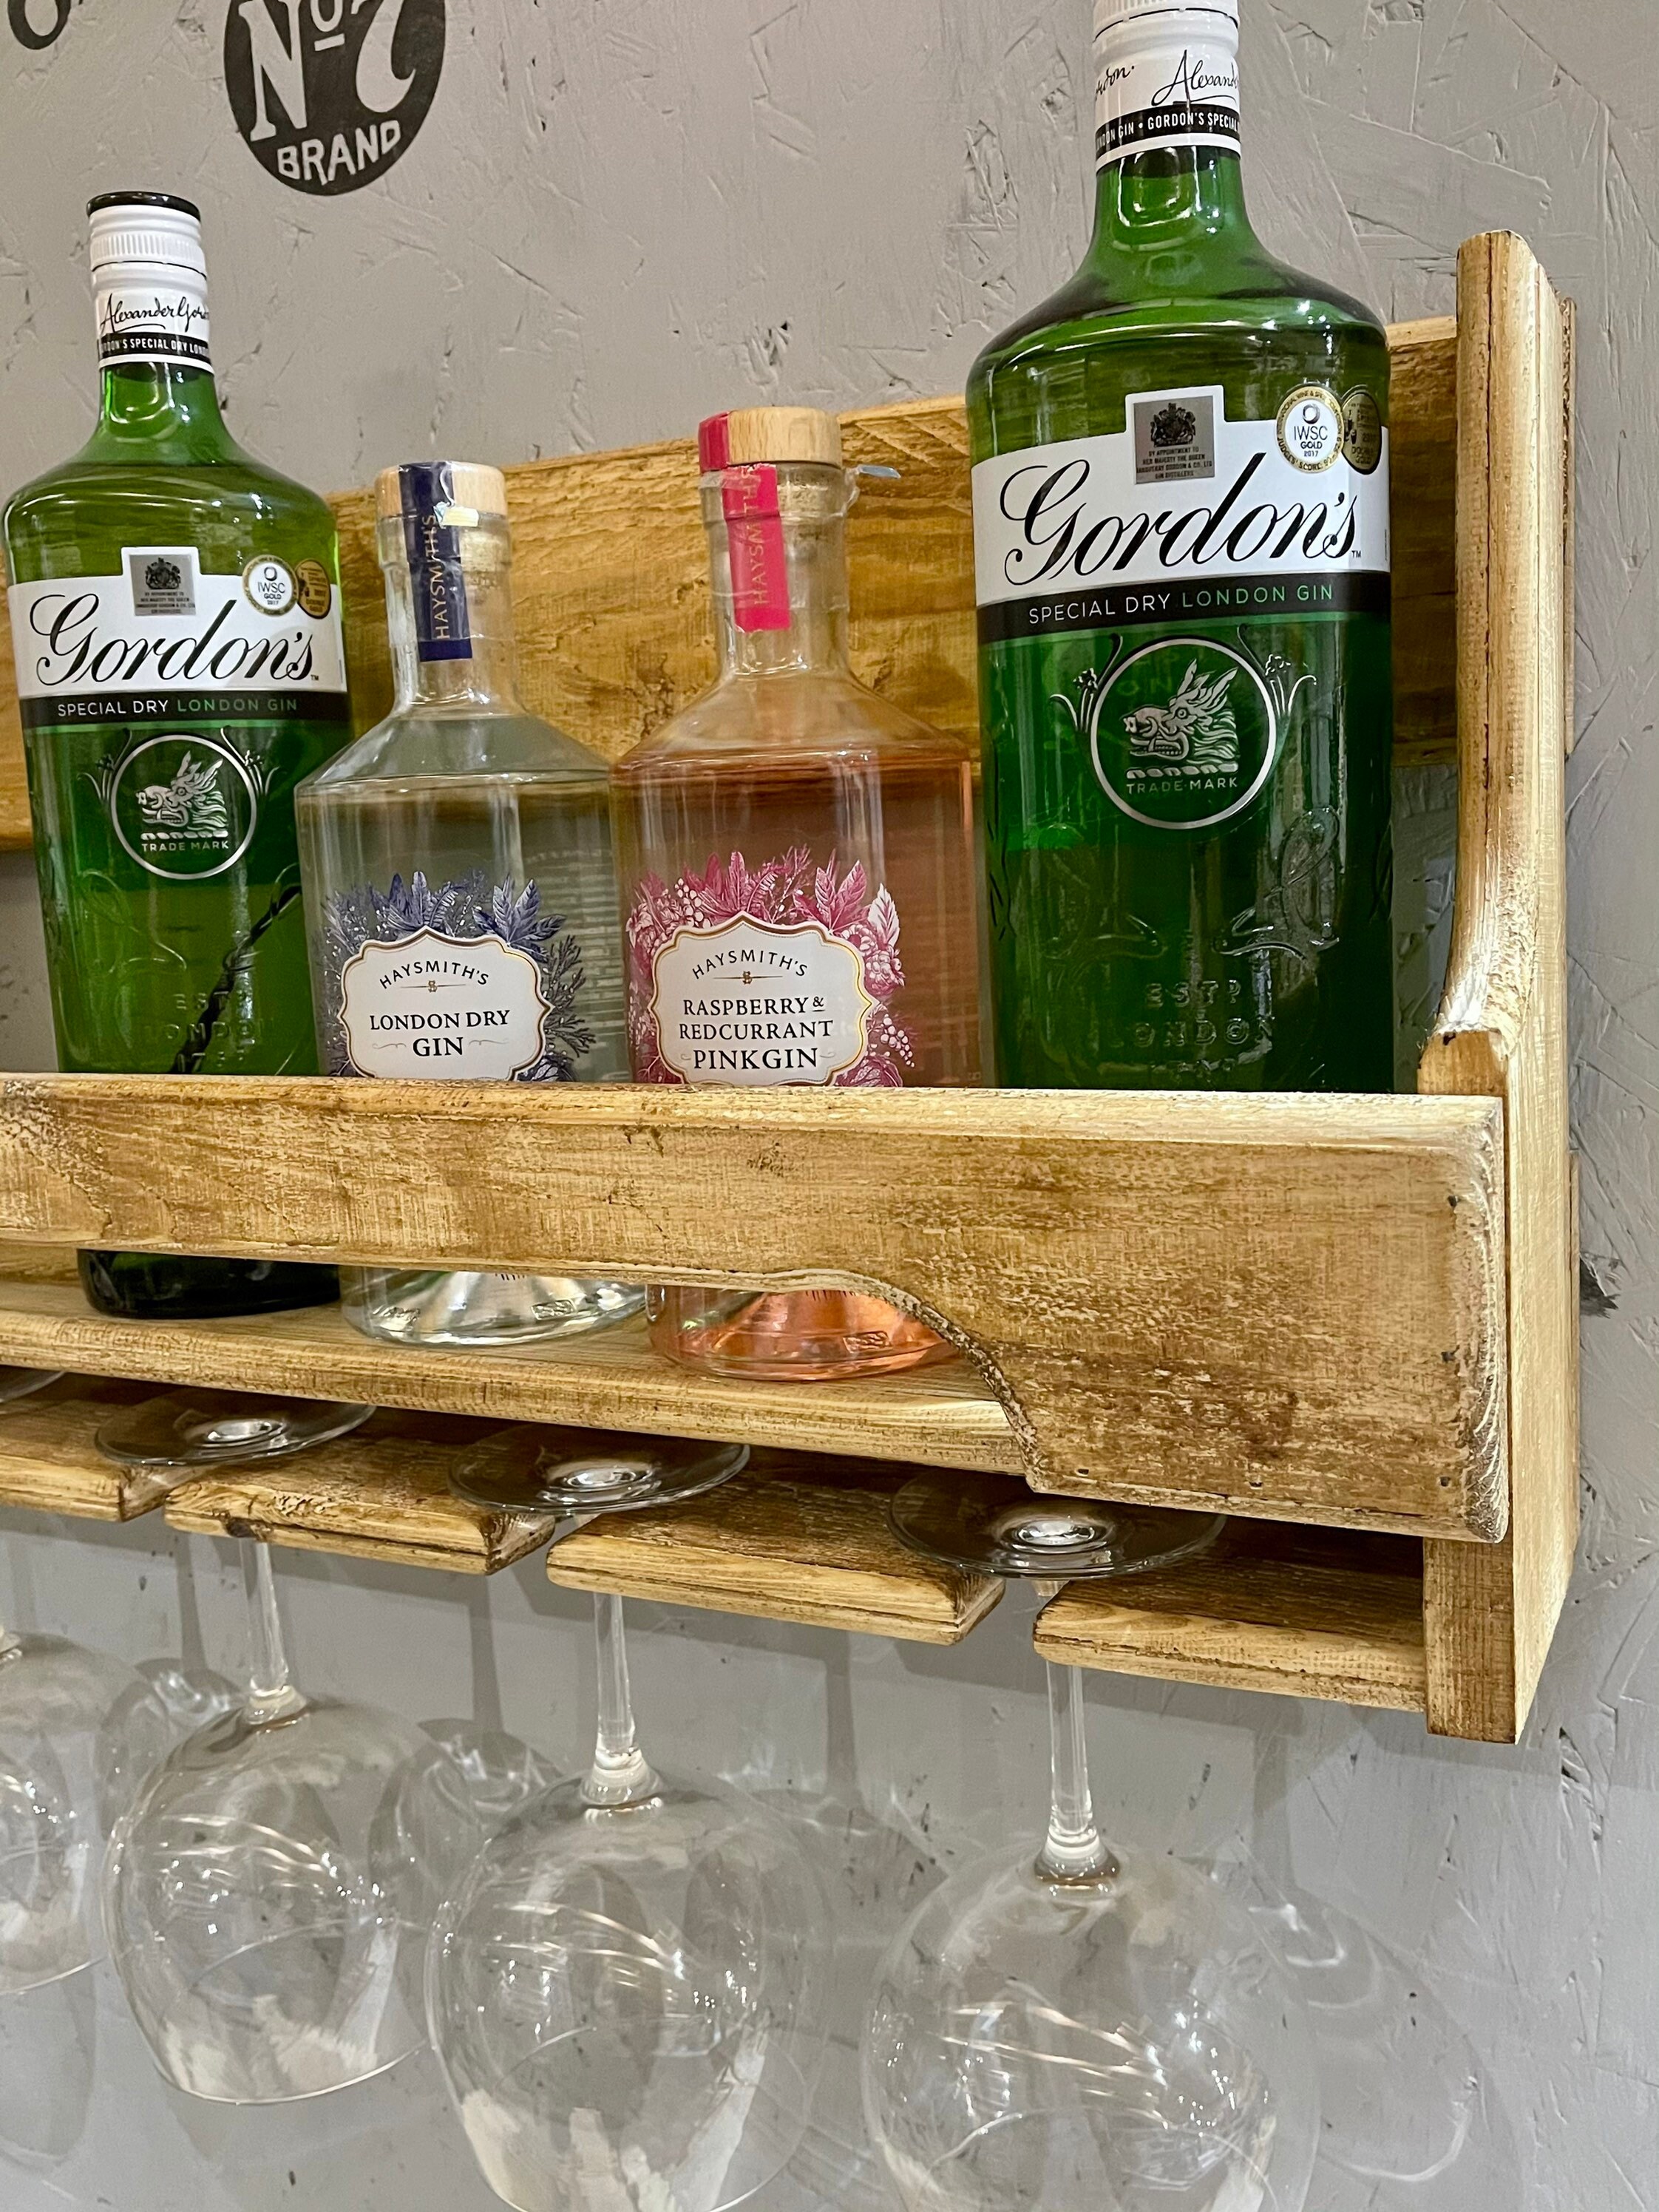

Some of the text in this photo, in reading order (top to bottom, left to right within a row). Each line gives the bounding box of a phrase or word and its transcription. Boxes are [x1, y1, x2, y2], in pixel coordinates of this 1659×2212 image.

[1118, 121, 1135, 138] GIN
[1147, 112, 1204, 130] GORDON'S
[276, 120, 401, 185] BRAND
[129, 337, 169, 350] SPECIAL
[171, 340, 188, 353] DRY
[1293, 425, 1329, 441] IWSC
[1300, 441, 1323, 449] GOLD
[1303, 449, 1319, 458] 2017
[1000, 452, 1358, 586] Gordon's
[257, 581, 286, 594] IWSC
[1028, 584, 1333, 625] SPECIAL DRY LONDON GIN
[29, 593, 314, 686] Gordon's
[58, 698, 297, 717] SPECIAL DRY LONDON GIN
[1126, 776, 1238, 795] TRADE MARK
[141, 840, 229, 852] TRADE MARK
[379, 960, 490, 990] HAYSMITH'S
[691, 949, 809, 980] HAYSMITH'S
[682, 996, 826, 1017] RASPBERRY &
[369, 1008, 511, 1031] LONDON DRY
[679, 1020, 834, 1041] REDCURRANT
[412, 1037, 464, 1058] GIN
